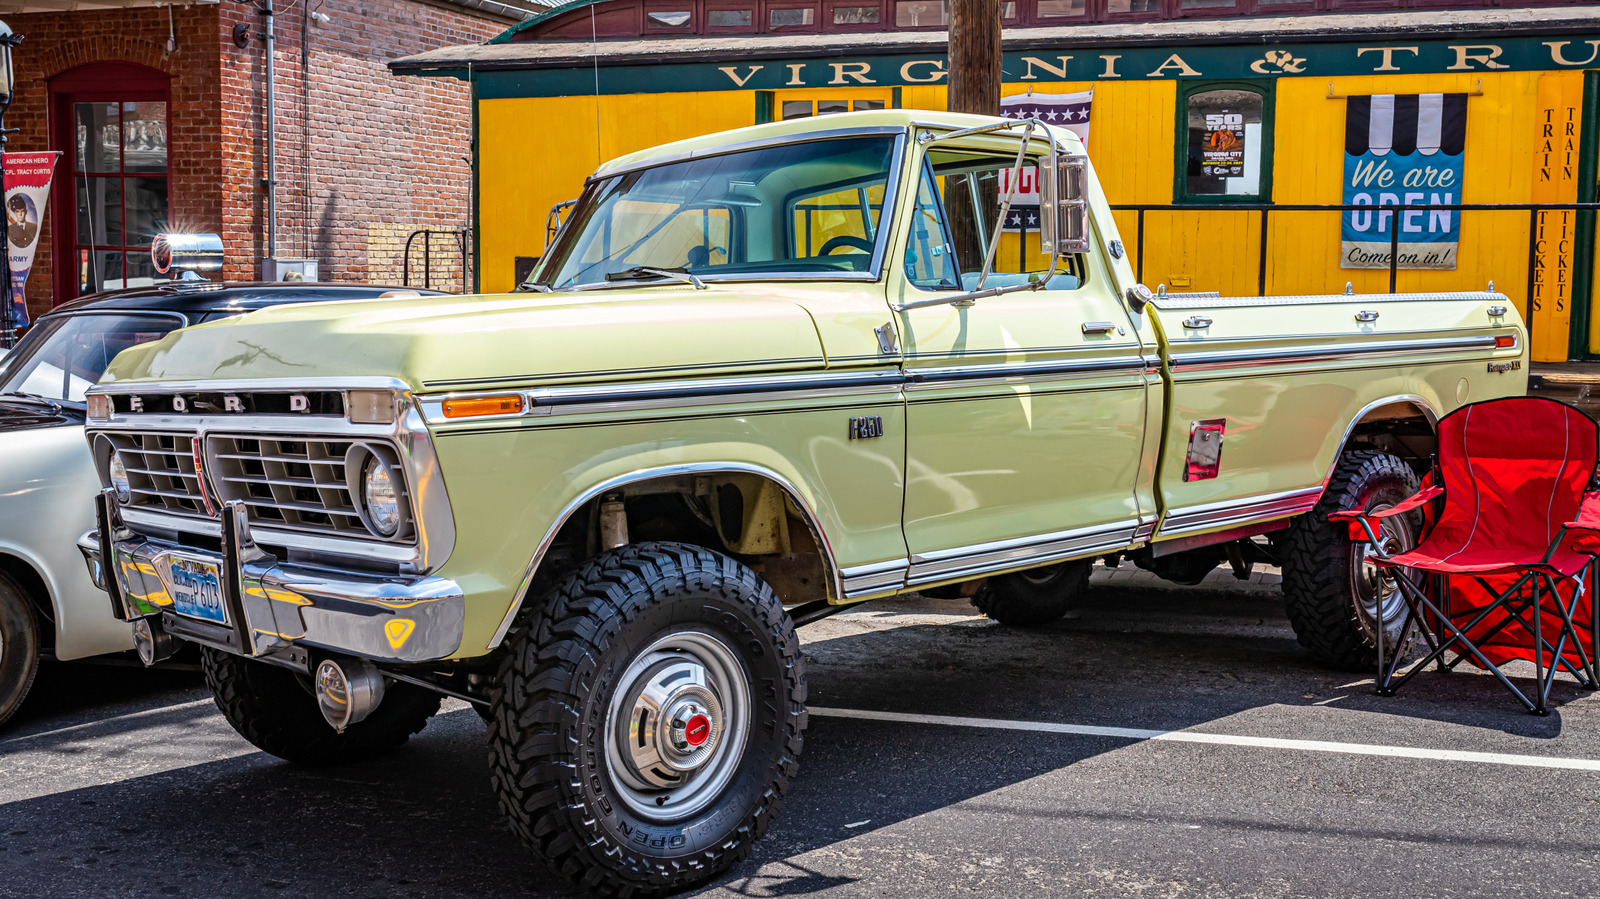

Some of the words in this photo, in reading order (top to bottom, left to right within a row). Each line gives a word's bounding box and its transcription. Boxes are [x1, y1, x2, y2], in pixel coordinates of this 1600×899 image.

[718, 54, 1202, 87] VIRGNIA
[1250, 50, 1307, 74] &
[1206, 114, 1242, 125] 50
[1540, 109, 1554, 182] TRAIN
[1563, 107, 1576, 180] TRAIN
[1351, 159, 1395, 188] We
[1402, 165, 1455, 188] are
[1351, 192, 1453, 233] OPEN
[9, 255, 28, 263] ARMY
[1347, 247, 1392, 264] Come
[1397, 252, 1419, 264] on
[1423, 248, 1451, 264] in!
[1533, 211, 1549, 312] TICKETS
[1556, 211, 1570, 312] TICKETS
[130, 395, 308, 412] FORD
[849, 415, 883, 440] F250
[616, 820, 688, 850] OPEN
